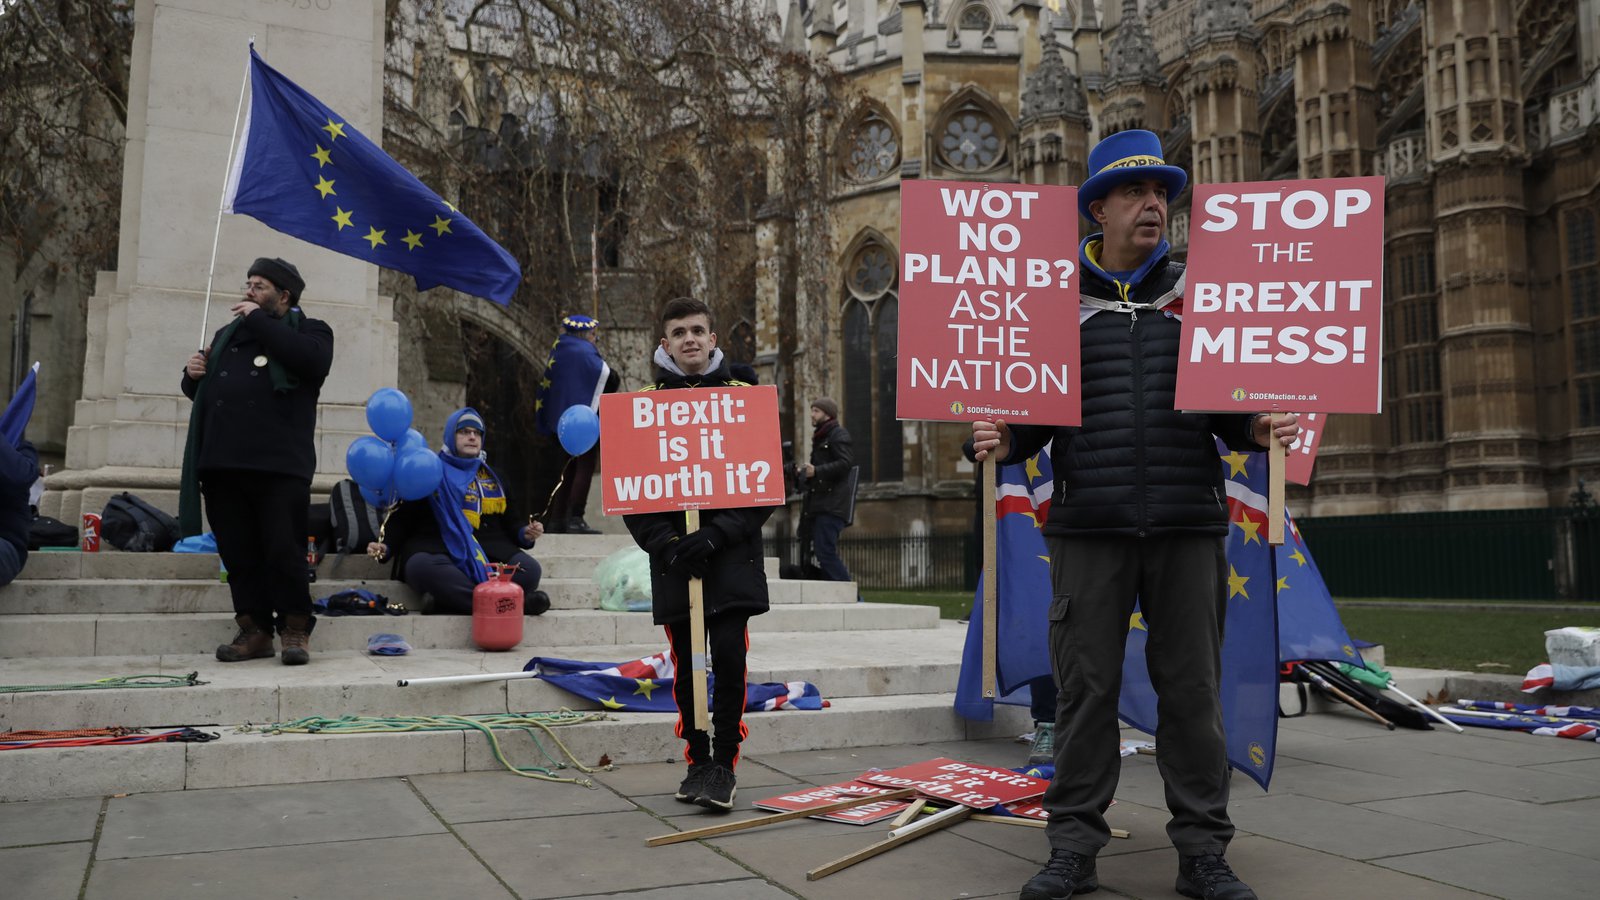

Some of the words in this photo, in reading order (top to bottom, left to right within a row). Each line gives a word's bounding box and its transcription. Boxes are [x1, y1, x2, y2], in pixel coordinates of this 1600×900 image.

[940, 187, 1039, 219] WOT
[1200, 188, 1372, 232] STOP
[959, 221, 1021, 253] NO
[1251, 241, 1314, 263] THE
[904, 252, 1017, 287] PLAN
[1026, 258, 1075, 289] B?
[949, 289, 1030, 322] ASK
[1192, 279, 1373, 313] BREXIT
[947, 323, 1031, 357] THE
[1189, 325, 1367, 365] MESS!
[909, 357, 1069, 395] NATION
[632, 392, 746, 429] Brexit:
[966, 405, 1029, 417] SODEMaction.co.uk
[1248, 392, 1318, 402] SODEMaction.co.uk
[657, 430, 689, 463] is
[699, 427, 726, 460] it
[613, 463, 714, 502] worth
[725, 460, 772, 496] it?
[867, 774, 955, 796] worth
[950, 790, 1002, 805] it?
[930, 772, 962, 782] is
[953, 777, 986, 789] it
[937, 762, 1037, 788] Brexit:
